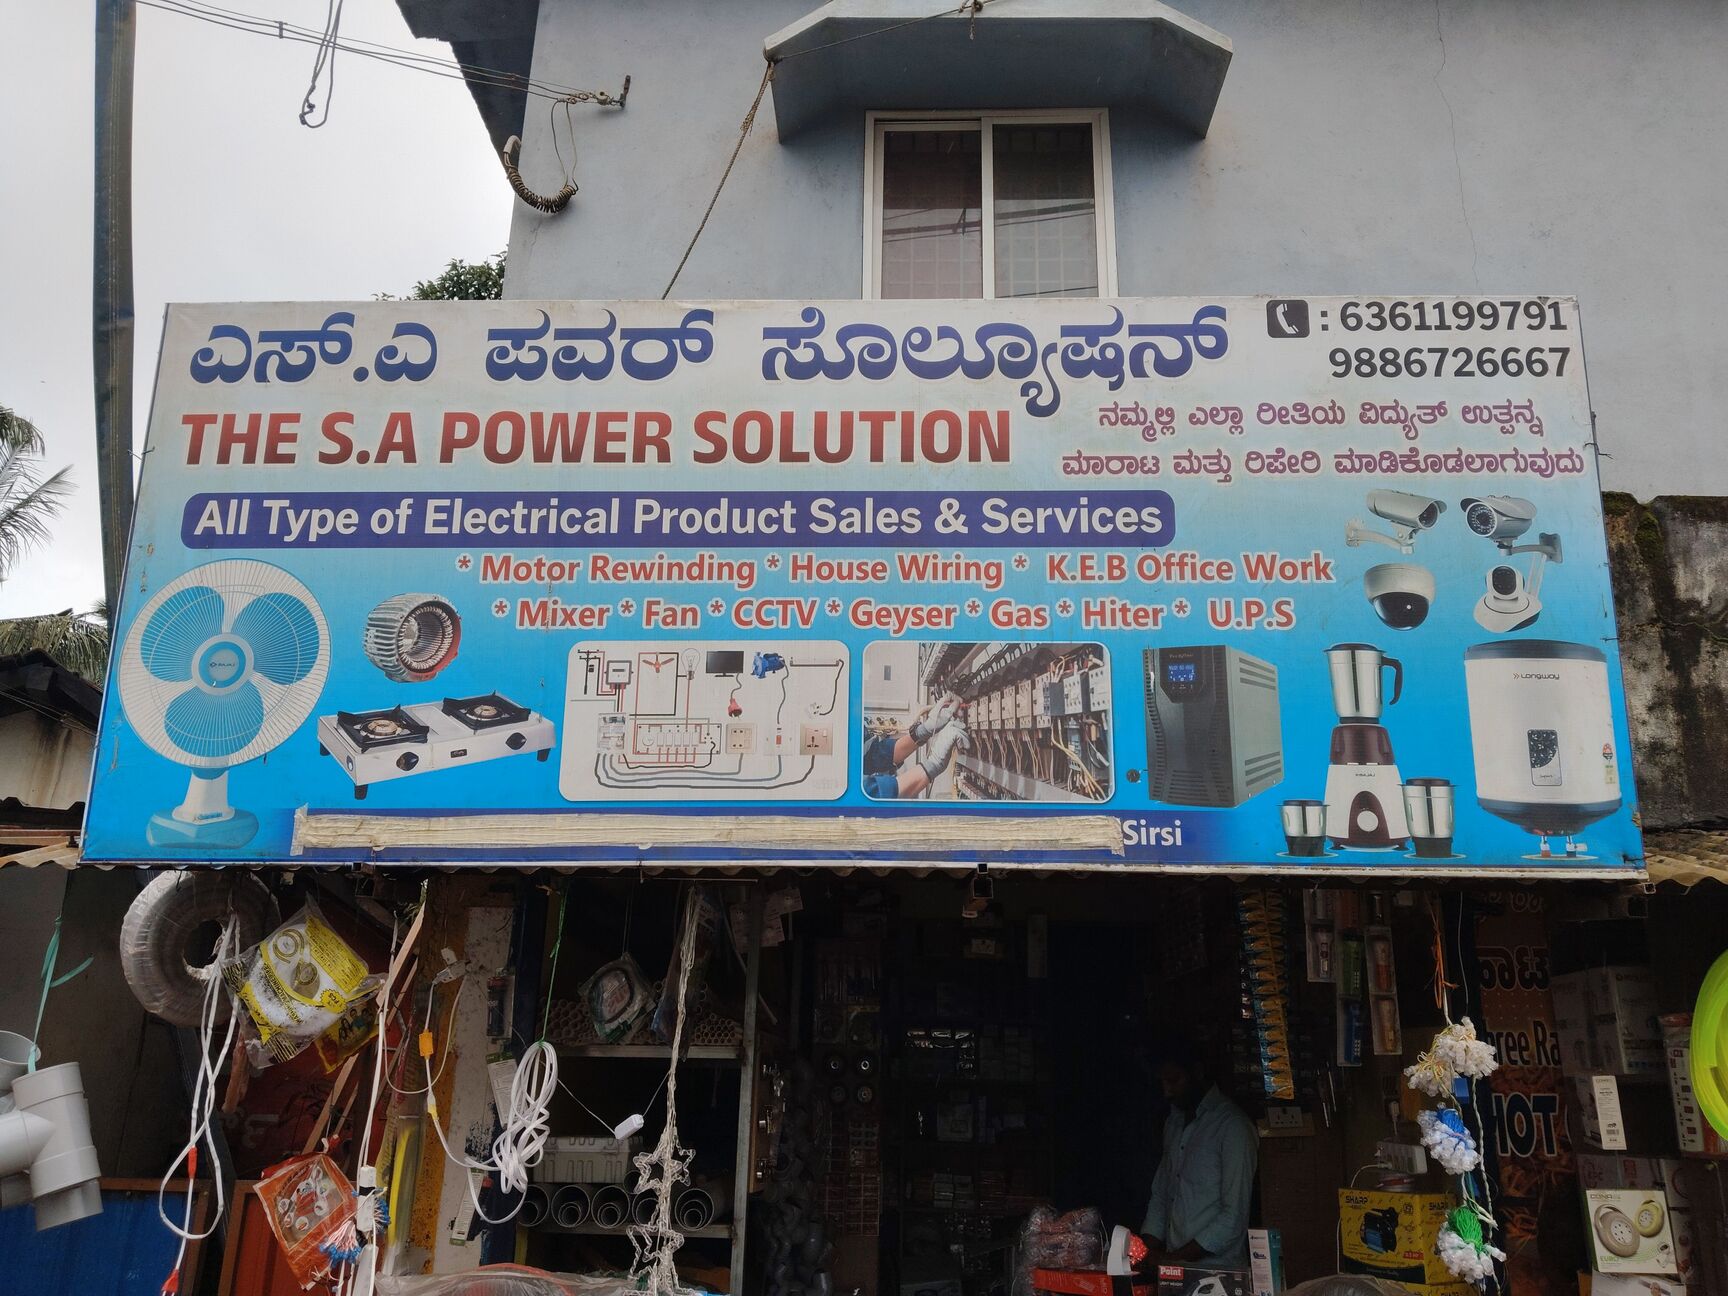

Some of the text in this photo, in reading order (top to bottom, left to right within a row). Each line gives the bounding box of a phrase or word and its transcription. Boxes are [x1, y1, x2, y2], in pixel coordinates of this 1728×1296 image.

[1340, 301, 1568, 332] 6361199791
[485, 308, 715, 382] ಪವರ್
[1329, 347, 1570, 378] 9886726667
[182, 410, 1011, 464] THE S.A POWER SOLUTION
[1099, 399, 1544, 442] ನಮ್ಮಲ್ಲಿ ಎಲ್ಲಾ ರೀತಿಯ ವಿದ್ಯುತ್ ಉತ್ಪನ್ನ
[1062, 447, 1585, 483] ಮಾರಾಟ ಮತ್ತು ರಿಪೇರಿ ಮಾಡಿಕೊಡಲಾಗುವುದು
[194, 497, 1162, 542] All Type of Electrical Product Sales & Services
[482, 553, 1333, 588] Motor Rewinding House Wiring K.E.B Office Work
[519, 599, 1295, 634] Mixer Fan CCTV Geyser Gas Hiter U.P.S
[1122, 819, 1182, 846] Sirsi
[1345, 1195, 1369, 1204] SHARP
[1160, 1266, 1182, 1276] Point
